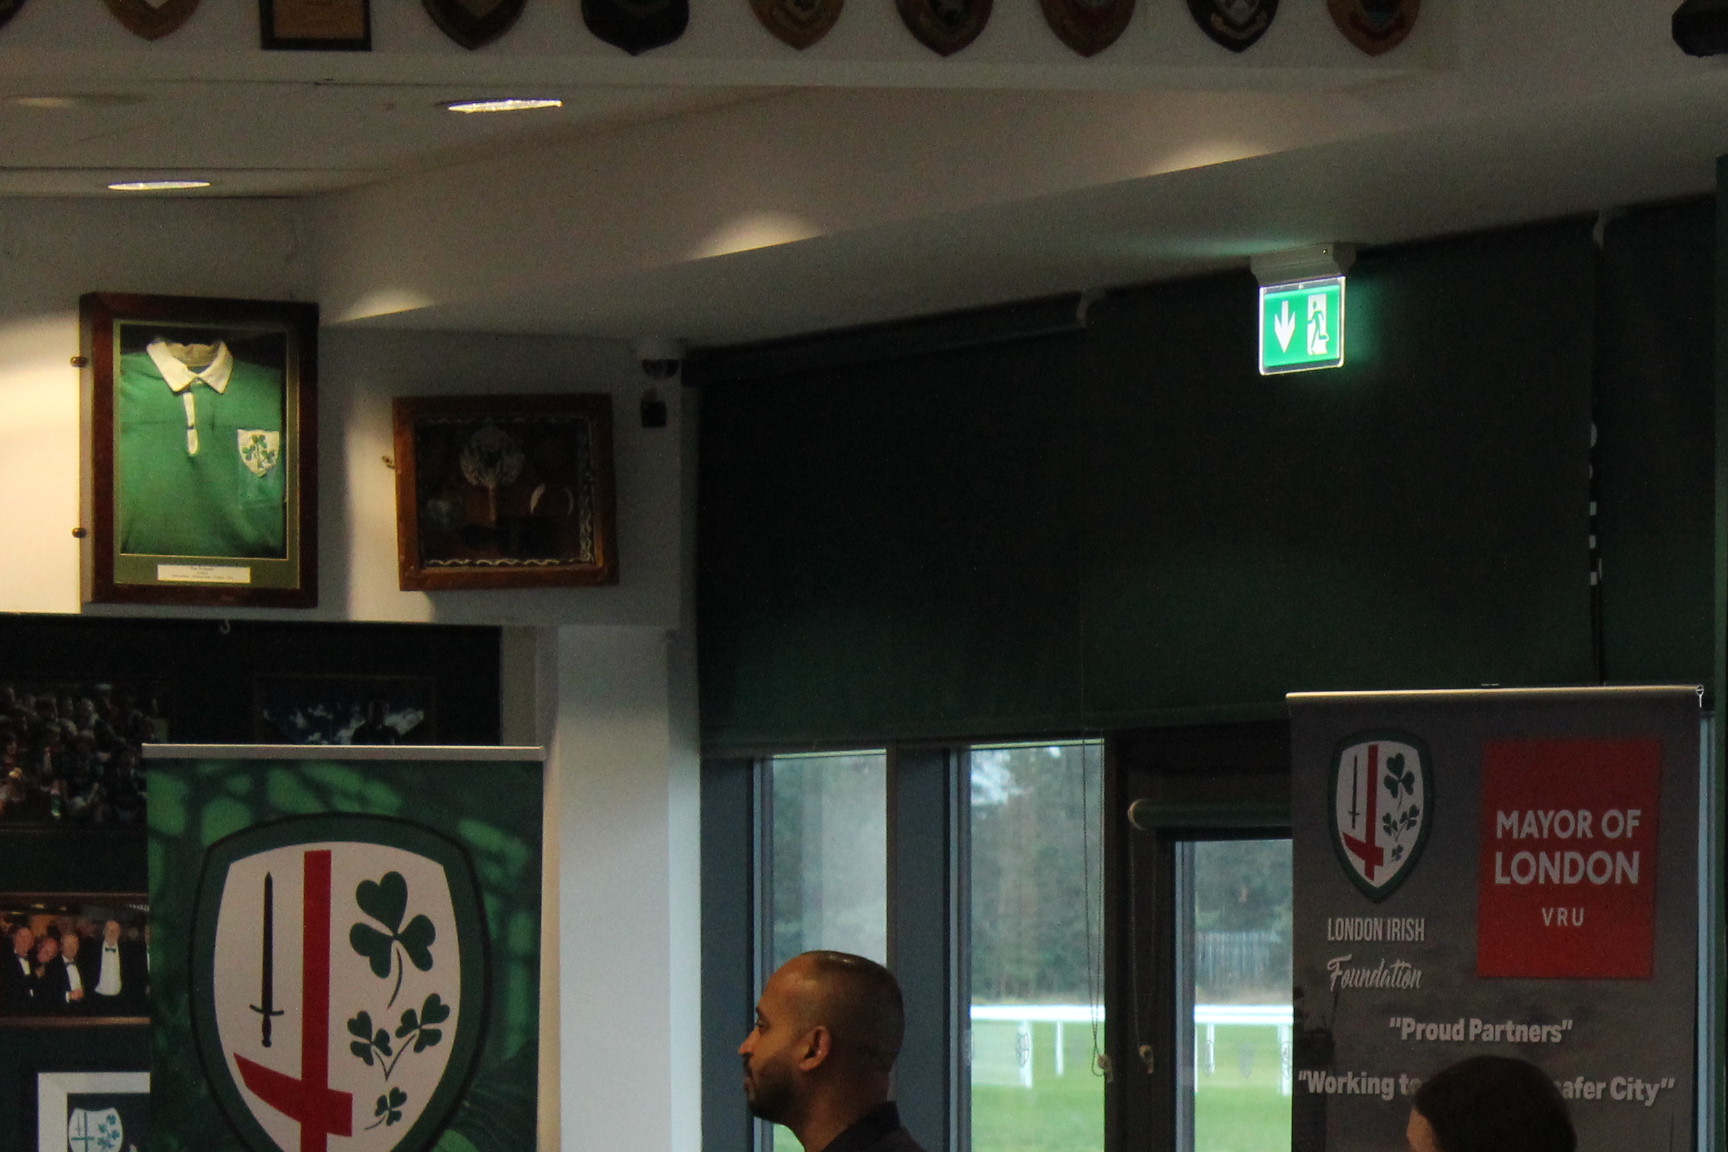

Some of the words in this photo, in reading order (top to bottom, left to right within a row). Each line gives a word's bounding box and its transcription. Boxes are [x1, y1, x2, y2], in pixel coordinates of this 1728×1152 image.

[1496, 809, 1594, 840] MAYOR
[1601, 808, 1642, 839] OF
[1493, 850, 1641, 885] LONDON
[1327, 917, 1383, 942] LONDON
[1387, 918, 1425, 942] IRISH
[1541, 907, 1585, 927] VRU
[1326, 953, 1422, 993] Foundation
